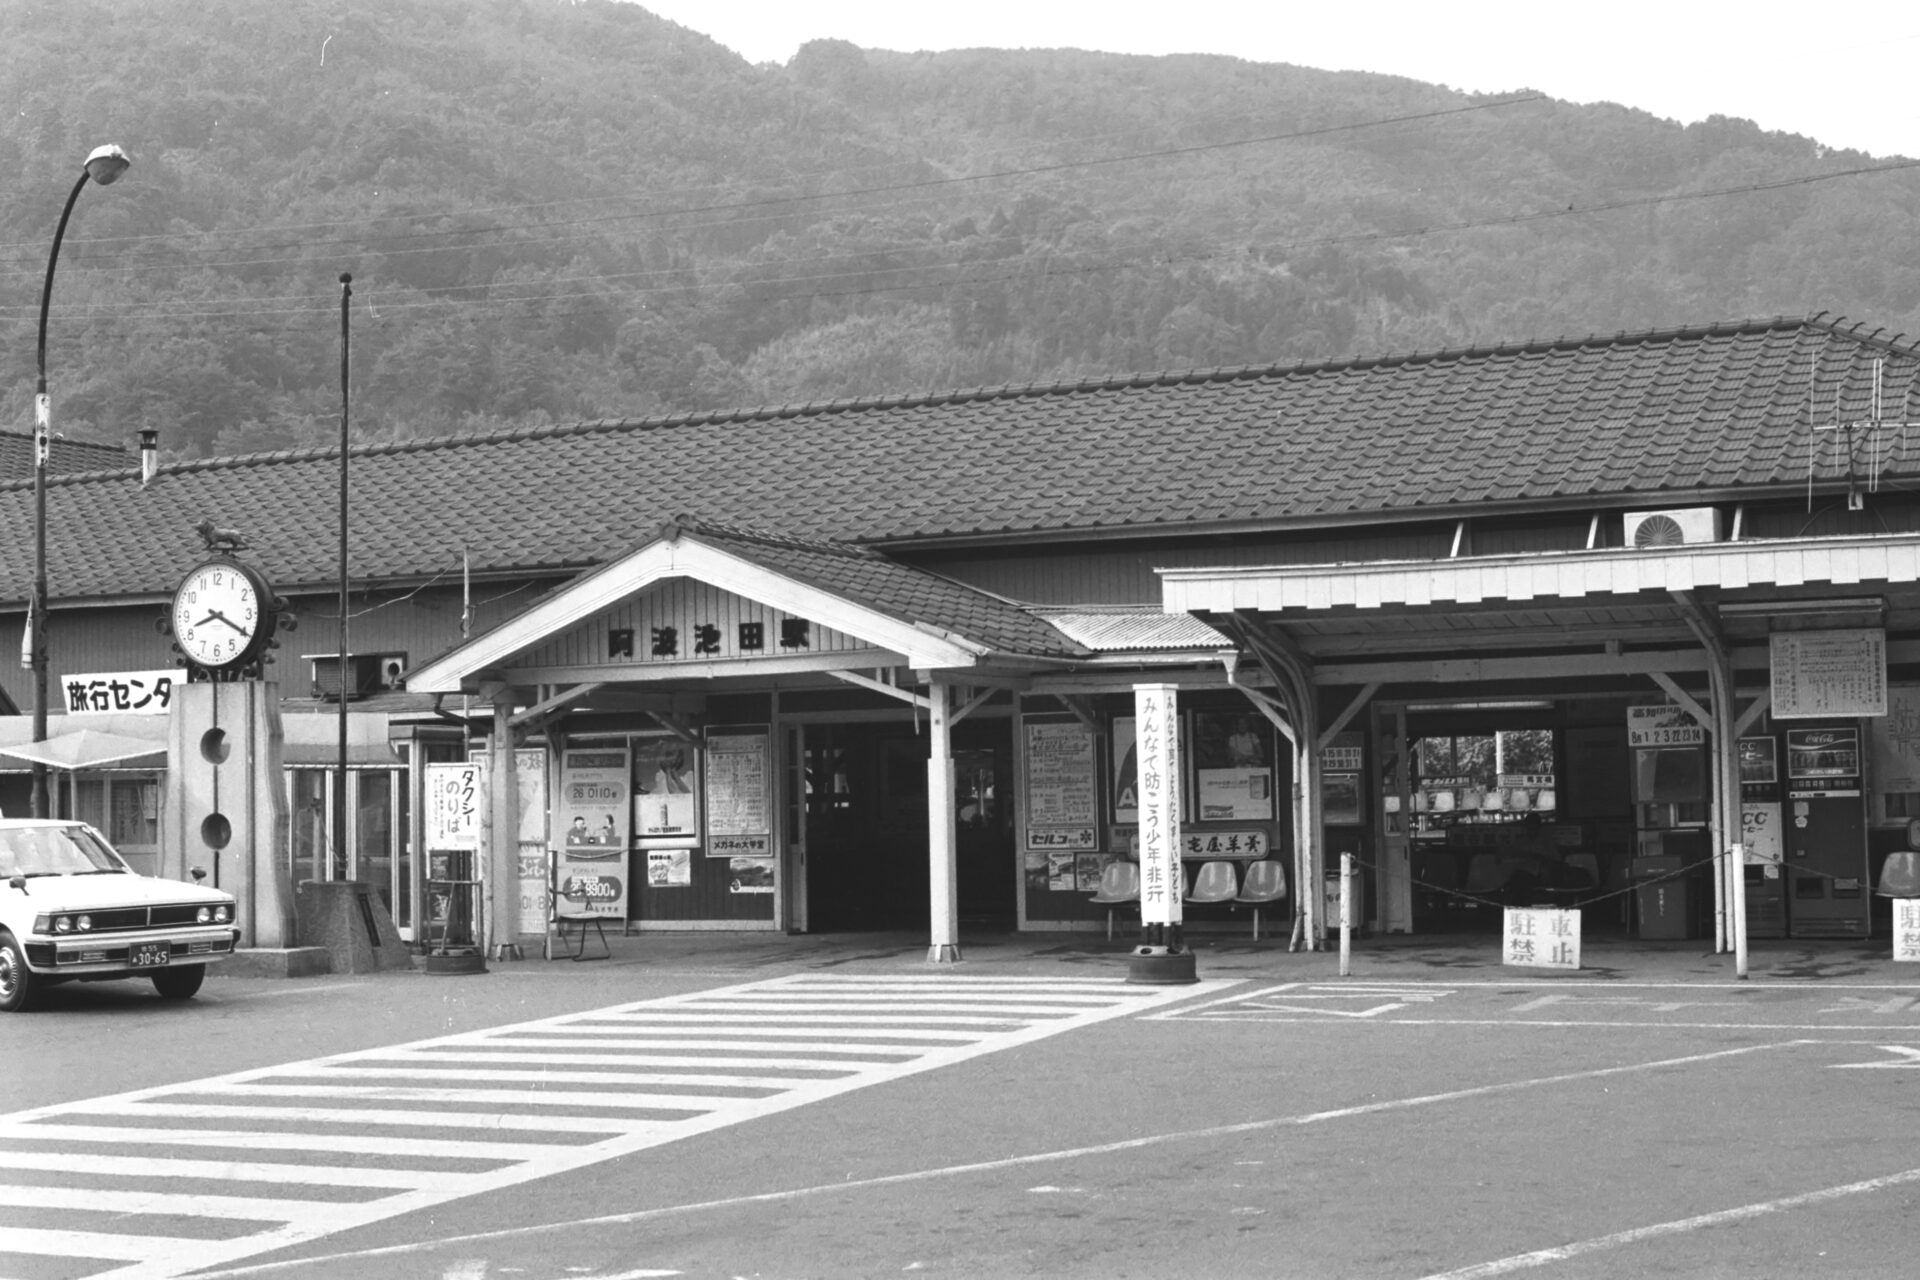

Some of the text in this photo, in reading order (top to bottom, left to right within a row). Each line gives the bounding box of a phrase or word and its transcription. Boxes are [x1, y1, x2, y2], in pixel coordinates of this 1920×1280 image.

[200, 577, 207, 590] 11
[213, 572, 222, 586] 12
[187, 591, 197, 604] 10
[241, 588, 249, 602] 2
[183, 609, 190, 623] 9
[245, 607, 253, 621] 3
[187, 628, 194, 641] 8
[199, 640, 207, 654] 7
[213, 643, 221, 657] 6
[228, 638, 236, 652] 5
[1739, 742, 1756, 751] CC
[462, 770, 475, 826] タクシー
[445, 780, 462, 833] のりば
[1742, 811, 1768, 825] CC
[1031, 834, 1068, 845] セルコ
[1181, 834, 1261, 853] 宅屋羊羹
[138, 950, 168, 966] 30-65
[1510, 938, 1574, 964] 禁止
